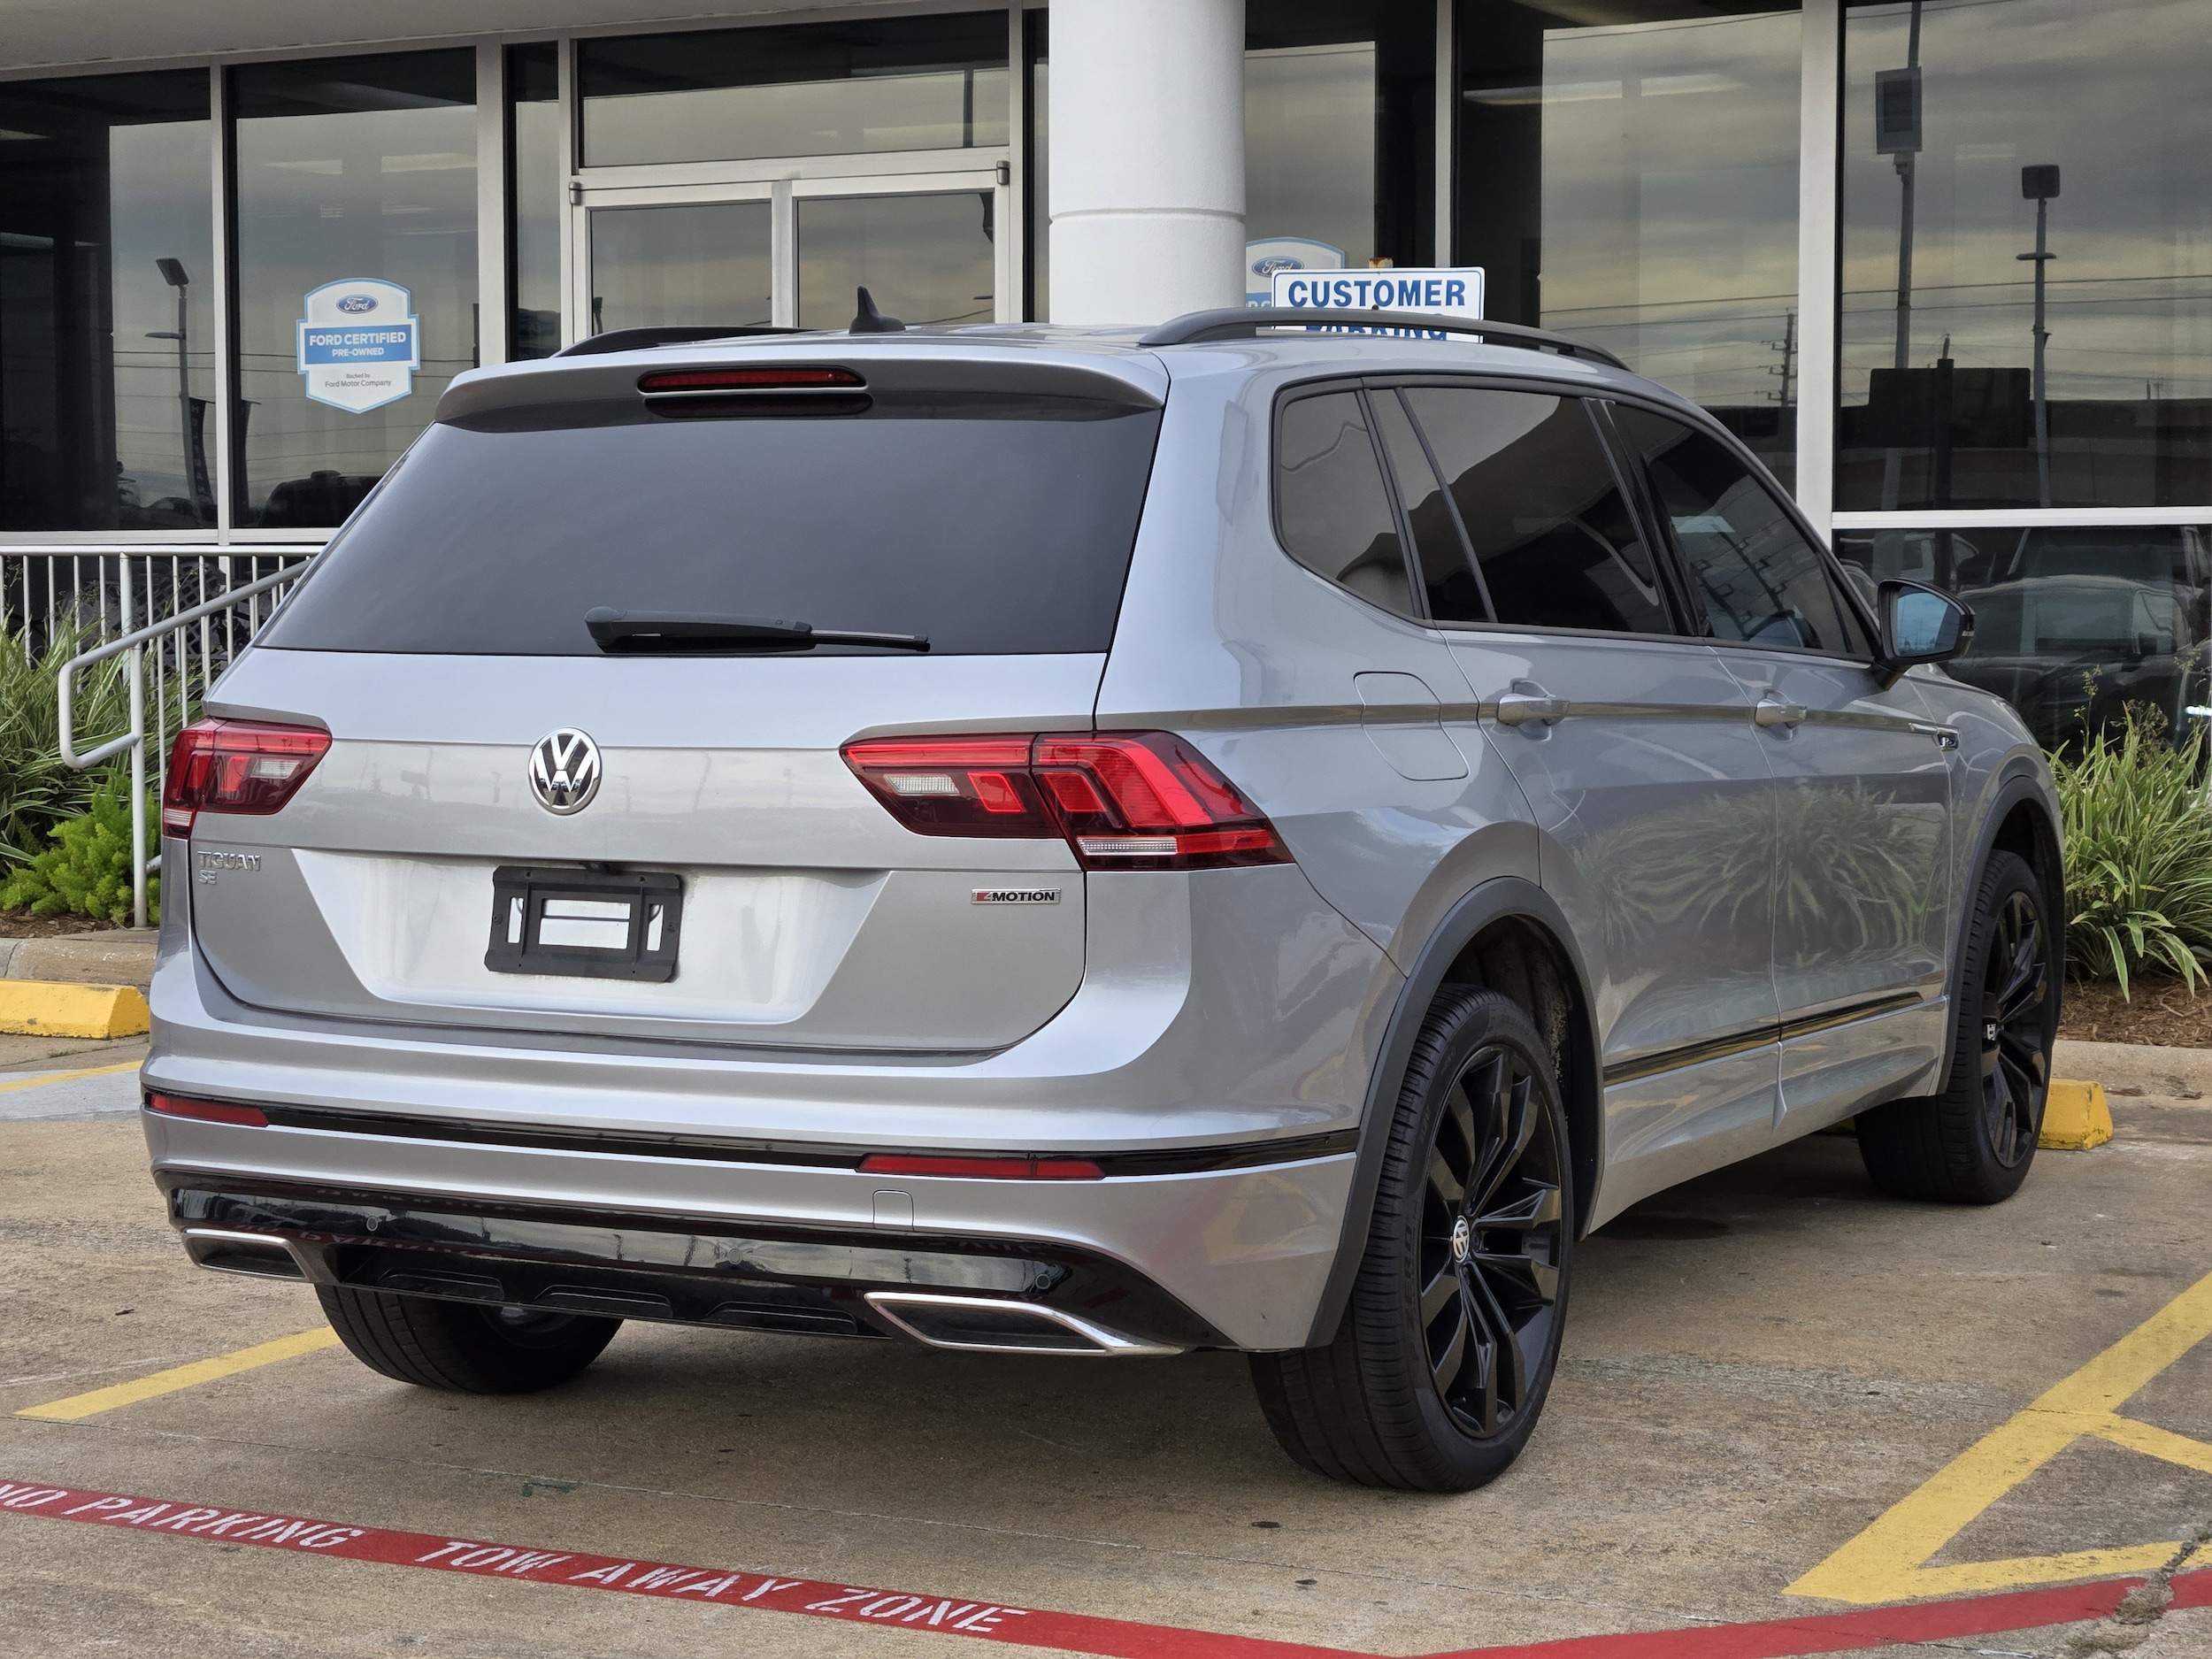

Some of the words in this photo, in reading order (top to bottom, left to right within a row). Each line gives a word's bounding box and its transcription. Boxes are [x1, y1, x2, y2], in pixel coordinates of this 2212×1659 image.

[1288, 280, 1465, 307] CUSTOMER
[343, 297, 370, 311] Ford
[309, 334, 342, 346] FORD
[344, 332, 406, 345] CERTIFIED
[332, 348, 385, 357] PRE-OWNED
[197, 850, 261, 872] TIGUAN
[198, 869, 217, 885] SE
[979, 892, 1055, 902] 4MOTION
[0, 1484, 68, 1509] NO
[61, 1496, 365, 1548] PARKING
[414, 1541, 572, 1573] TOW
[568, 1563, 803, 1601] AWAY
[804, 1587, 1032, 1632] ZONE
